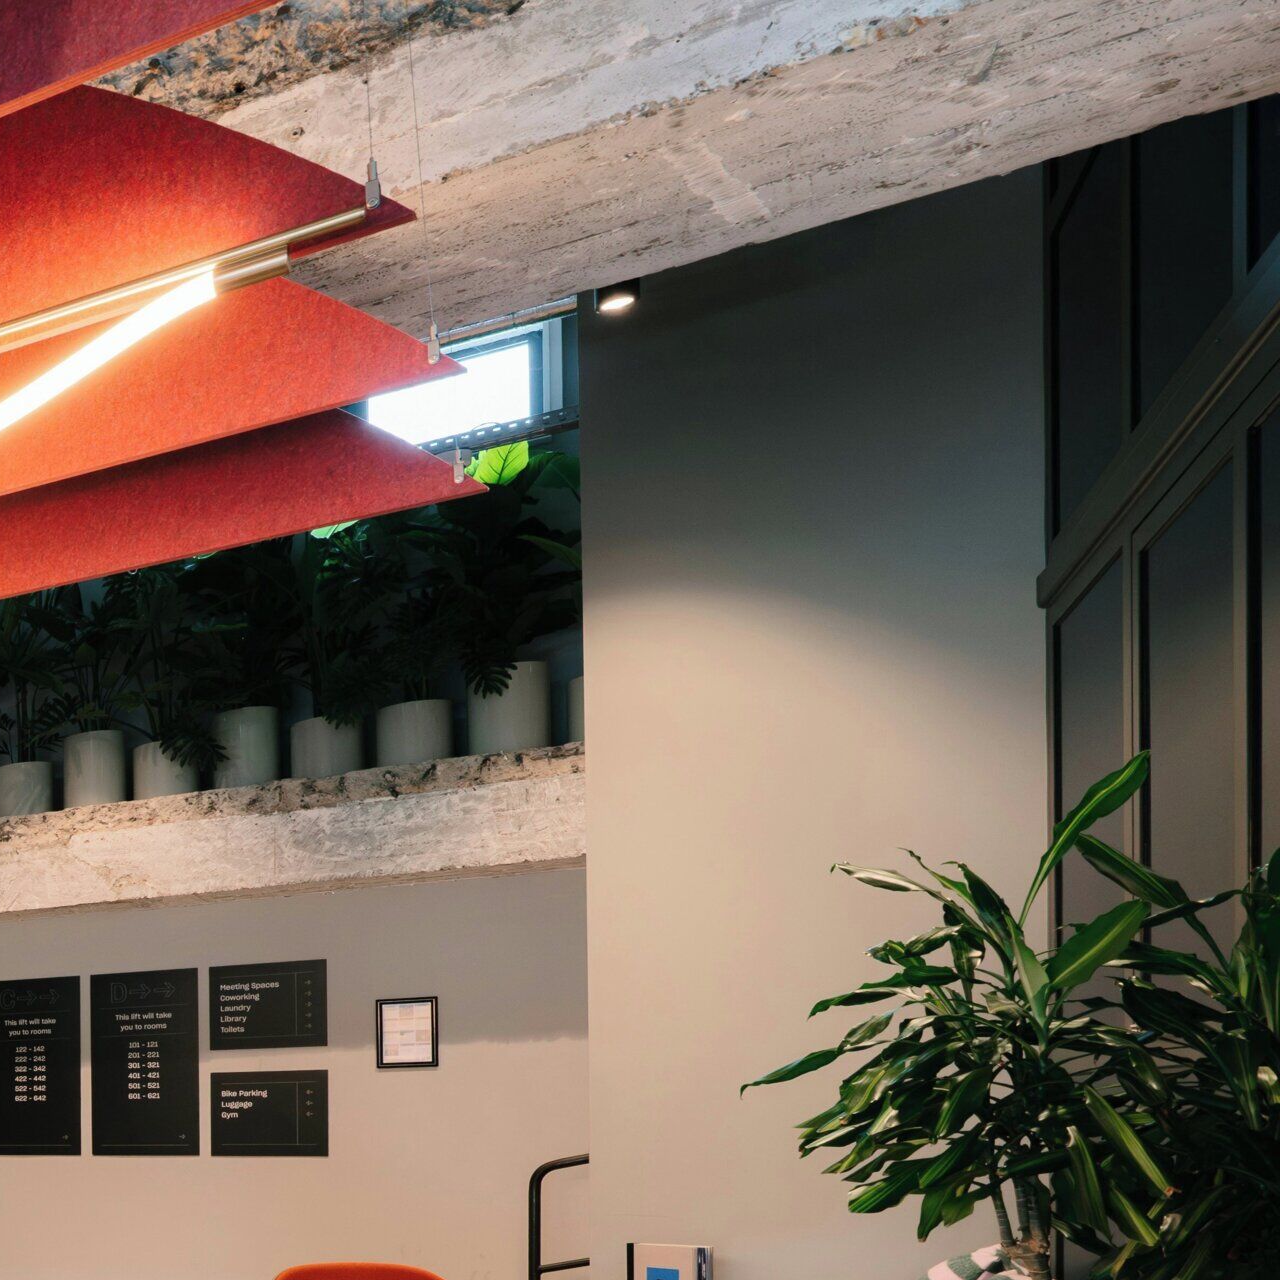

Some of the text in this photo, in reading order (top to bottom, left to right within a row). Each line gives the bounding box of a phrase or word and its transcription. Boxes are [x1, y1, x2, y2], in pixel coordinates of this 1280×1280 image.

[220, 982, 279, 991] Meeting Spaces
[111, 982, 127, 1004] D
[220, 993, 260, 1001] Coworking
[0, 988, 16, 1010] C
[220, 1004, 251, 1012] Laundry
[239, 1090, 267, 1098] Parking
[221, 1101, 253, 1109] Luggage
